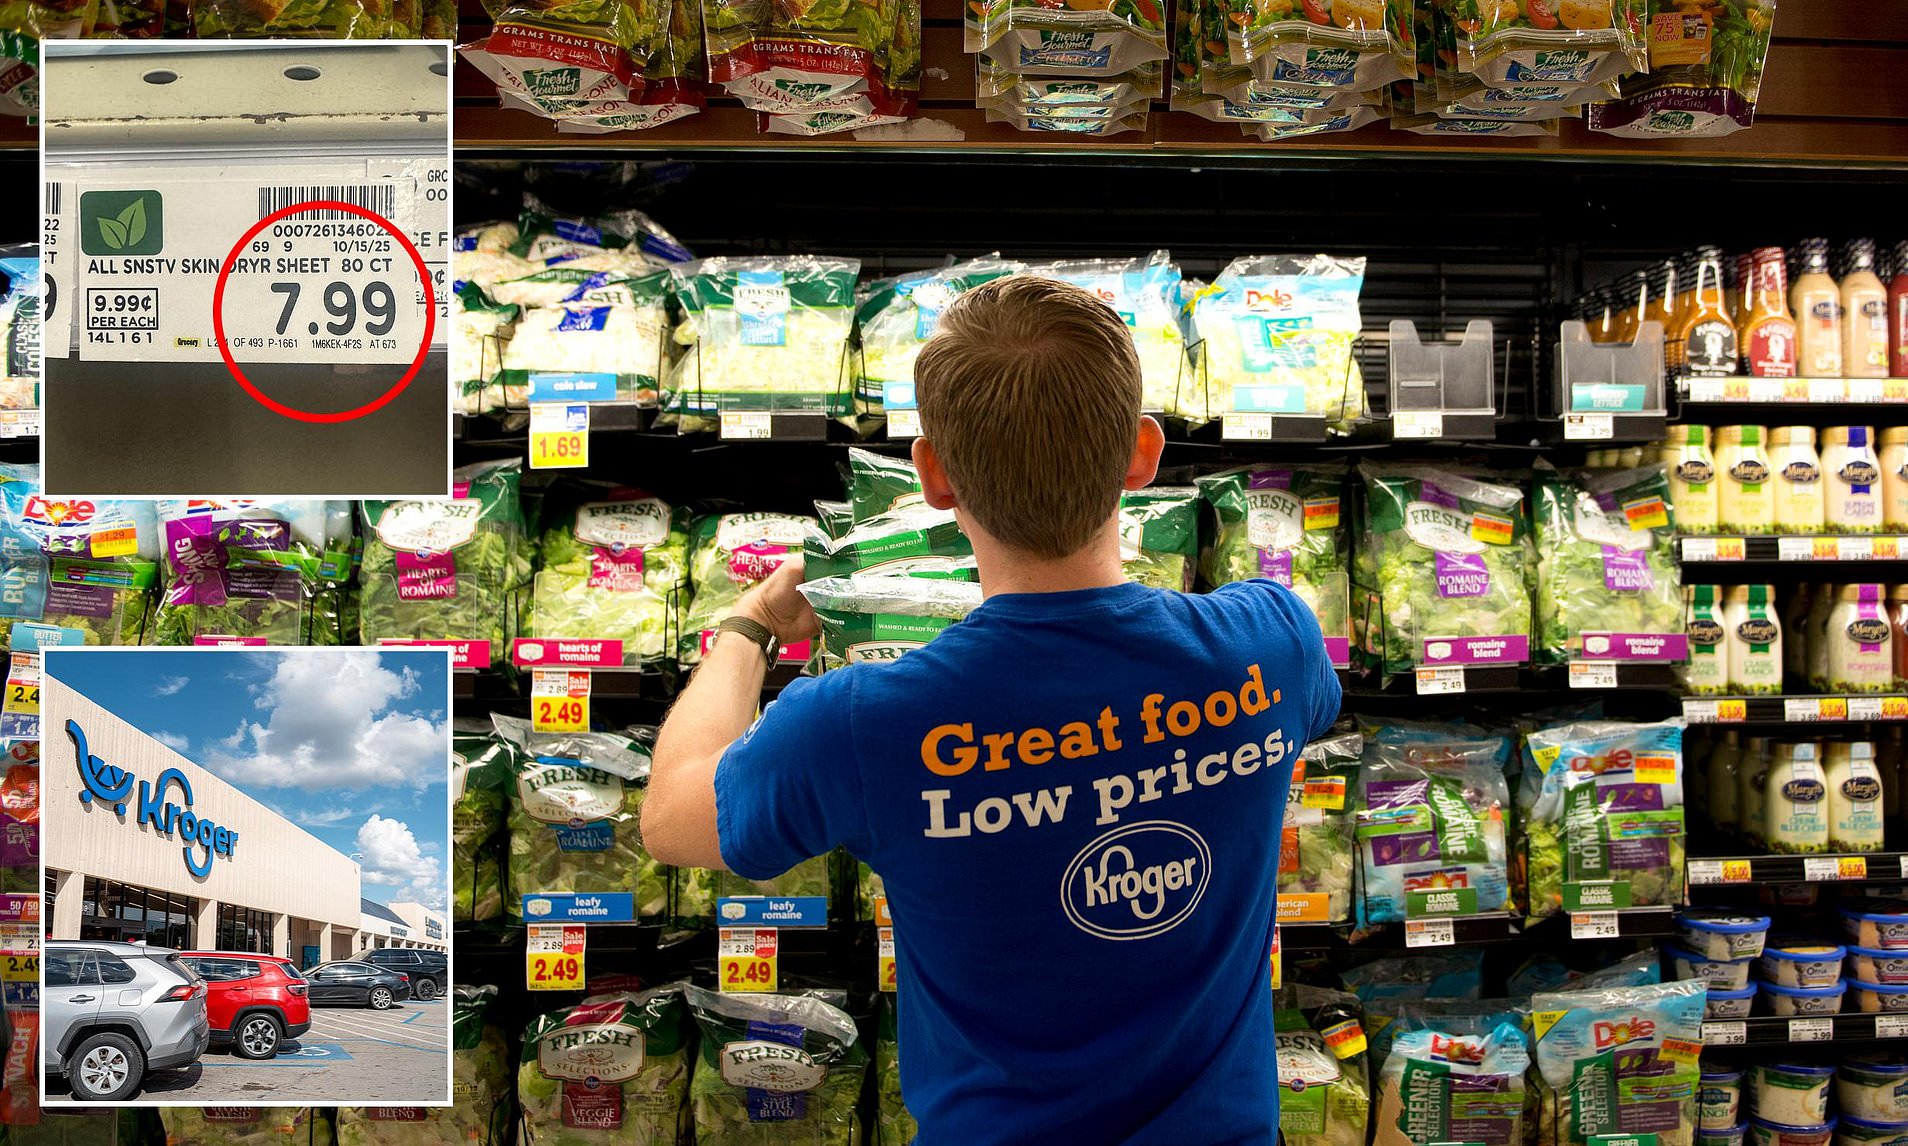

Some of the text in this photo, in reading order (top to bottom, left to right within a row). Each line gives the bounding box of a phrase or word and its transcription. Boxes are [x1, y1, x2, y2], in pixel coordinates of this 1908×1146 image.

[503, 26, 590, 48] GRAMS TRANS
[1051, 30, 1085, 42] Fresh
[1654, 33, 1680, 42] NOW
[758, 44, 794, 52] GRAMS
[800, 45, 838, 56] TRANS
[1041, 36, 1091, 51] Gourmet
[1315, 49, 1350, 64] Fresh
[1544, 50, 1579, 65] Fresh
[534, 70, 572, 87] Fresh
[528, 77, 578, 96] Gourmet
[786, 80, 823, 102] Fresh
[1671, 87, 1705, 98] TRANS
[252, 240, 293, 253] 69 9
[333, 239, 391, 254] 10/15/25
[88, 258, 119, 275] ALL
[123, 258, 177, 275] SNSTV
[181, 258, 220, 275] SKIN
[276, 257, 331, 274] SHEET
[341, 258, 364, 273] 80
[370, 257, 393, 273] CT
[94, 294, 152, 313] 9.99¢
[270, 280, 397, 336] 7.99
[91, 316, 156, 327] PER EACH
[88, 332, 153, 344] 14L 1 6 1
[233, 337, 246, 348] OF
[248, 338, 264, 348] 493
[268, 338, 298, 349] P-1661
[369, 339, 381, 349] AT
[382, 339, 397, 349] 673
[539, 436, 581, 458] 1.69
[24, 496, 96, 524] Dole
[588, 501, 662, 519] FRESH
[1249, 494, 1297, 518] RESH
[1412, 507, 1472, 538] FRESH
[735, 554, 776, 568] HEARTS
[406, 567, 449, 579] HEARTS
[1438, 573, 1488, 587] ROMAINE
[401, 584, 455, 598] ROMAINE
[1447, 583, 1481, 595] BLEND
[878, 623, 902, 631] WASHED
[908, 624, 927, 632] READY
[459, 643, 470, 654] of
[559, 642, 603, 653] hearts of
[1467, 639, 1507, 650] romaine
[1625, 637, 1665, 647] romaine
[1473, 647, 1501, 658] blend
[1630, 644, 1659, 655] blend
[559, 652, 601, 662] romaine
[569, 676, 589, 684] Sale
[1441, 680, 1462, 691] 2.49
[1594, 675, 1614, 685] 2.49
[548, 685, 568, 694] 2.89
[540, 701, 583, 724] 2.49
[920, 663, 1282, 777] Great food.
[526, 766, 611, 794] FRESH
[921, 727, 1295, 839] Low prices.
[137, 767, 239, 879] Kroger
[1432, 783, 1468, 857] ROMAINE
[1453, 799, 1477, 845] CLASSIC
[560, 836, 613, 849] ROMAINE
[1083, 844, 1197, 920] Kroger
[1580, 885, 1612, 896] CLASSIC
[575, 897, 601, 908] leafy
[1426, 892, 1458, 904] CLASSIC
[567, 906, 609, 916] romaine
[768, 900, 796, 913] leafy
[762, 909, 803, 920] romaine
[563, 931, 584, 940] Sale
[1596, 925, 1615, 935] 2.49
[755, 934, 777, 944] Sale
[1431, 933, 1451, 943] 2.49
[543, 941, 563, 950] 2.89
[735, 944, 755, 954] 2.89
[534, 958, 578, 981] 2.49
[727, 962, 771, 984] 2.49
[551, 1027, 637, 1050] FRESH
[1593, 1016, 1657, 1048] Dole
[1812, 1031, 1831, 1041] 3.99
[1725, 1035, 1744, 1044] 3.99
[730, 1044, 816, 1069] FRESH
[554, 1063, 630, 1077] SELECTIONS
[1578, 1063, 1598, 1135] GREENER
[1594, 1065, 1609, 1125] SELECTION
[762, 1101, 793, 1111] STYLE
[1427, 1077, 1441, 1138] SELECTION
[574, 1107, 615, 1120] VEGGIE
[759, 1107, 795, 1119] BLEND
